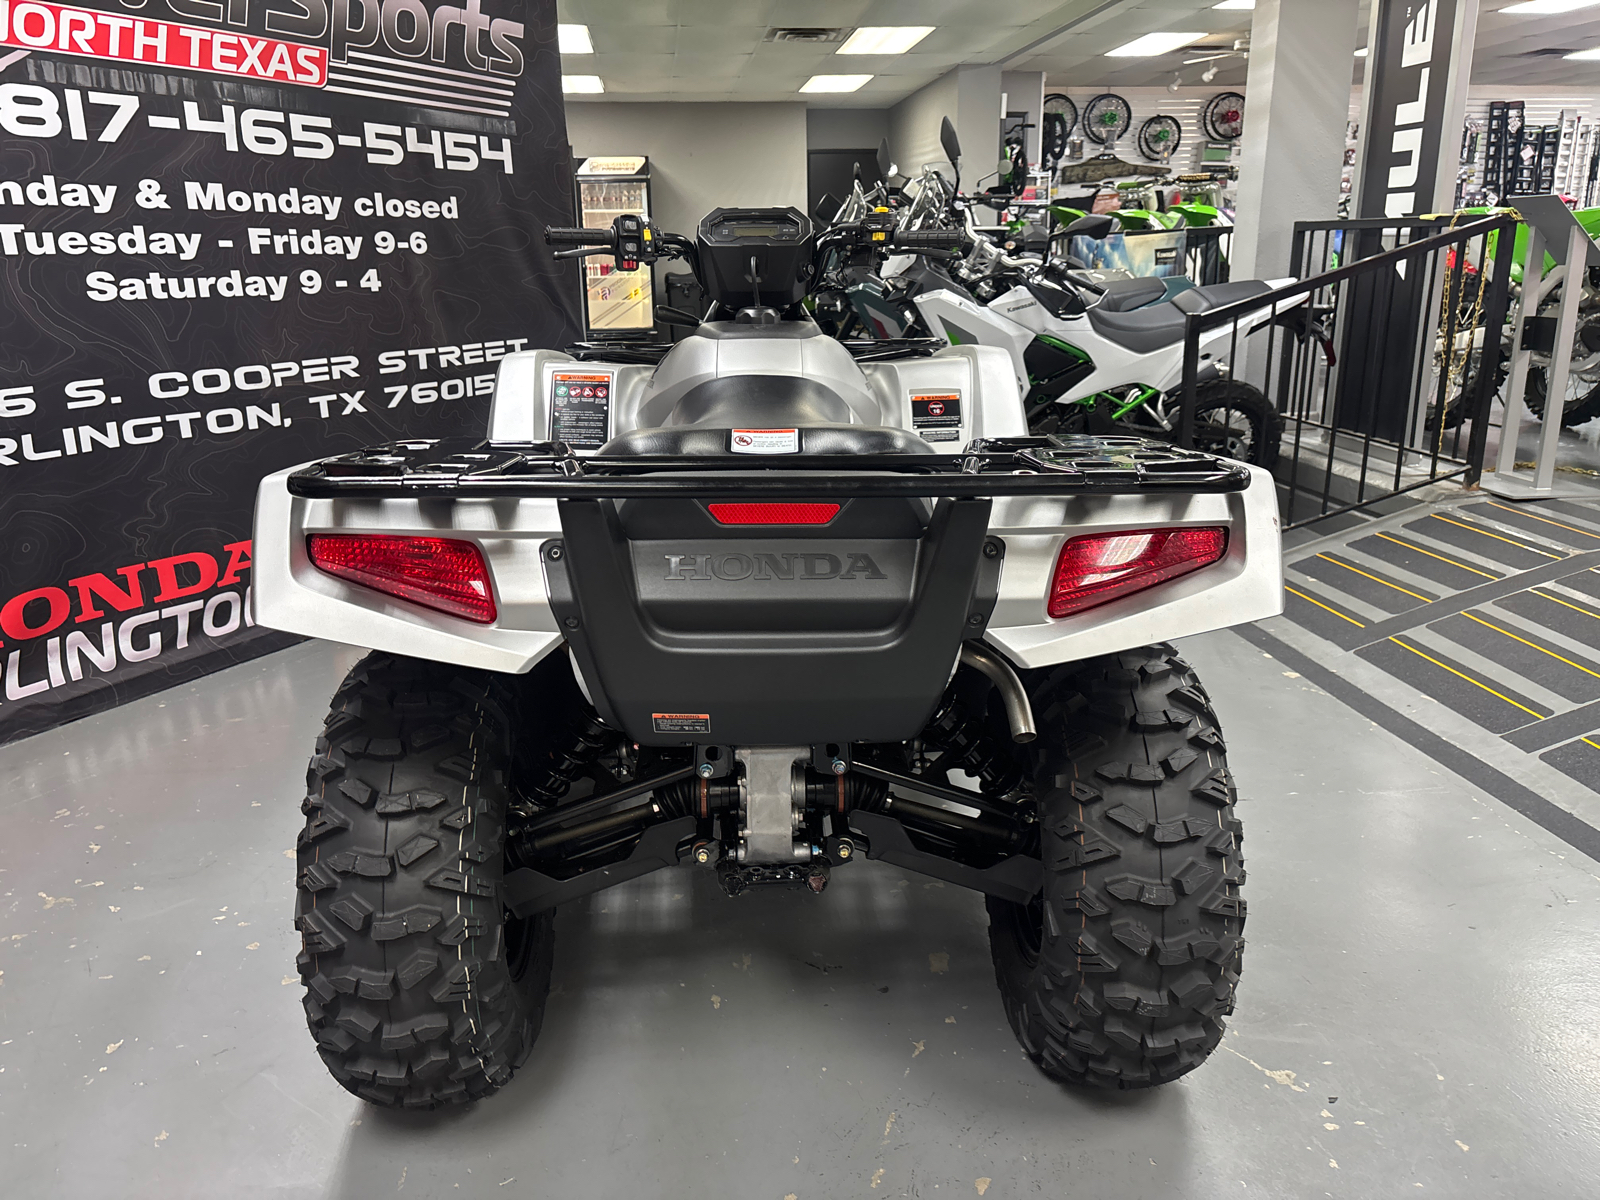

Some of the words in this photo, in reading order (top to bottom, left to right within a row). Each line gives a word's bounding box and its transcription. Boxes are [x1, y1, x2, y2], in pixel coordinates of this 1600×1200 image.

[0, 0, 167, 62] ORTH
[179, 27, 320, 84] TEXAS
[0, 82, 514, 175] 817-465-5454
[135, 178, 171, 210] &
[184, 181, 342, 220] Monday
[354, 192, 459, 219] closed
[0, 223, 201, 260] Tuesday
[218, 239, 233, 247] -
[247, 227, 363, 260] Friday
[374, 231, 428, 254] 9-6
[86, 269, 288, 301] Saturday
[299, 269, 322, 294] 9
[335, 279, 348, 288] -
[359, 268, 382, 292] 4
[1006, 300, 1038, 313] Kawasaki
[64, 378, 122, 409] S.
[148, 355, 360, 398] COOPER
[378, 338, 528, 374] STREET
[309, 390, 368, 419] TX
[384, 373, 496, 409] 76015
[664, 553, 888, 581] HONDA
[0, 539, 252, 648] OND
[0, 586, 255, 703] LINGTO
